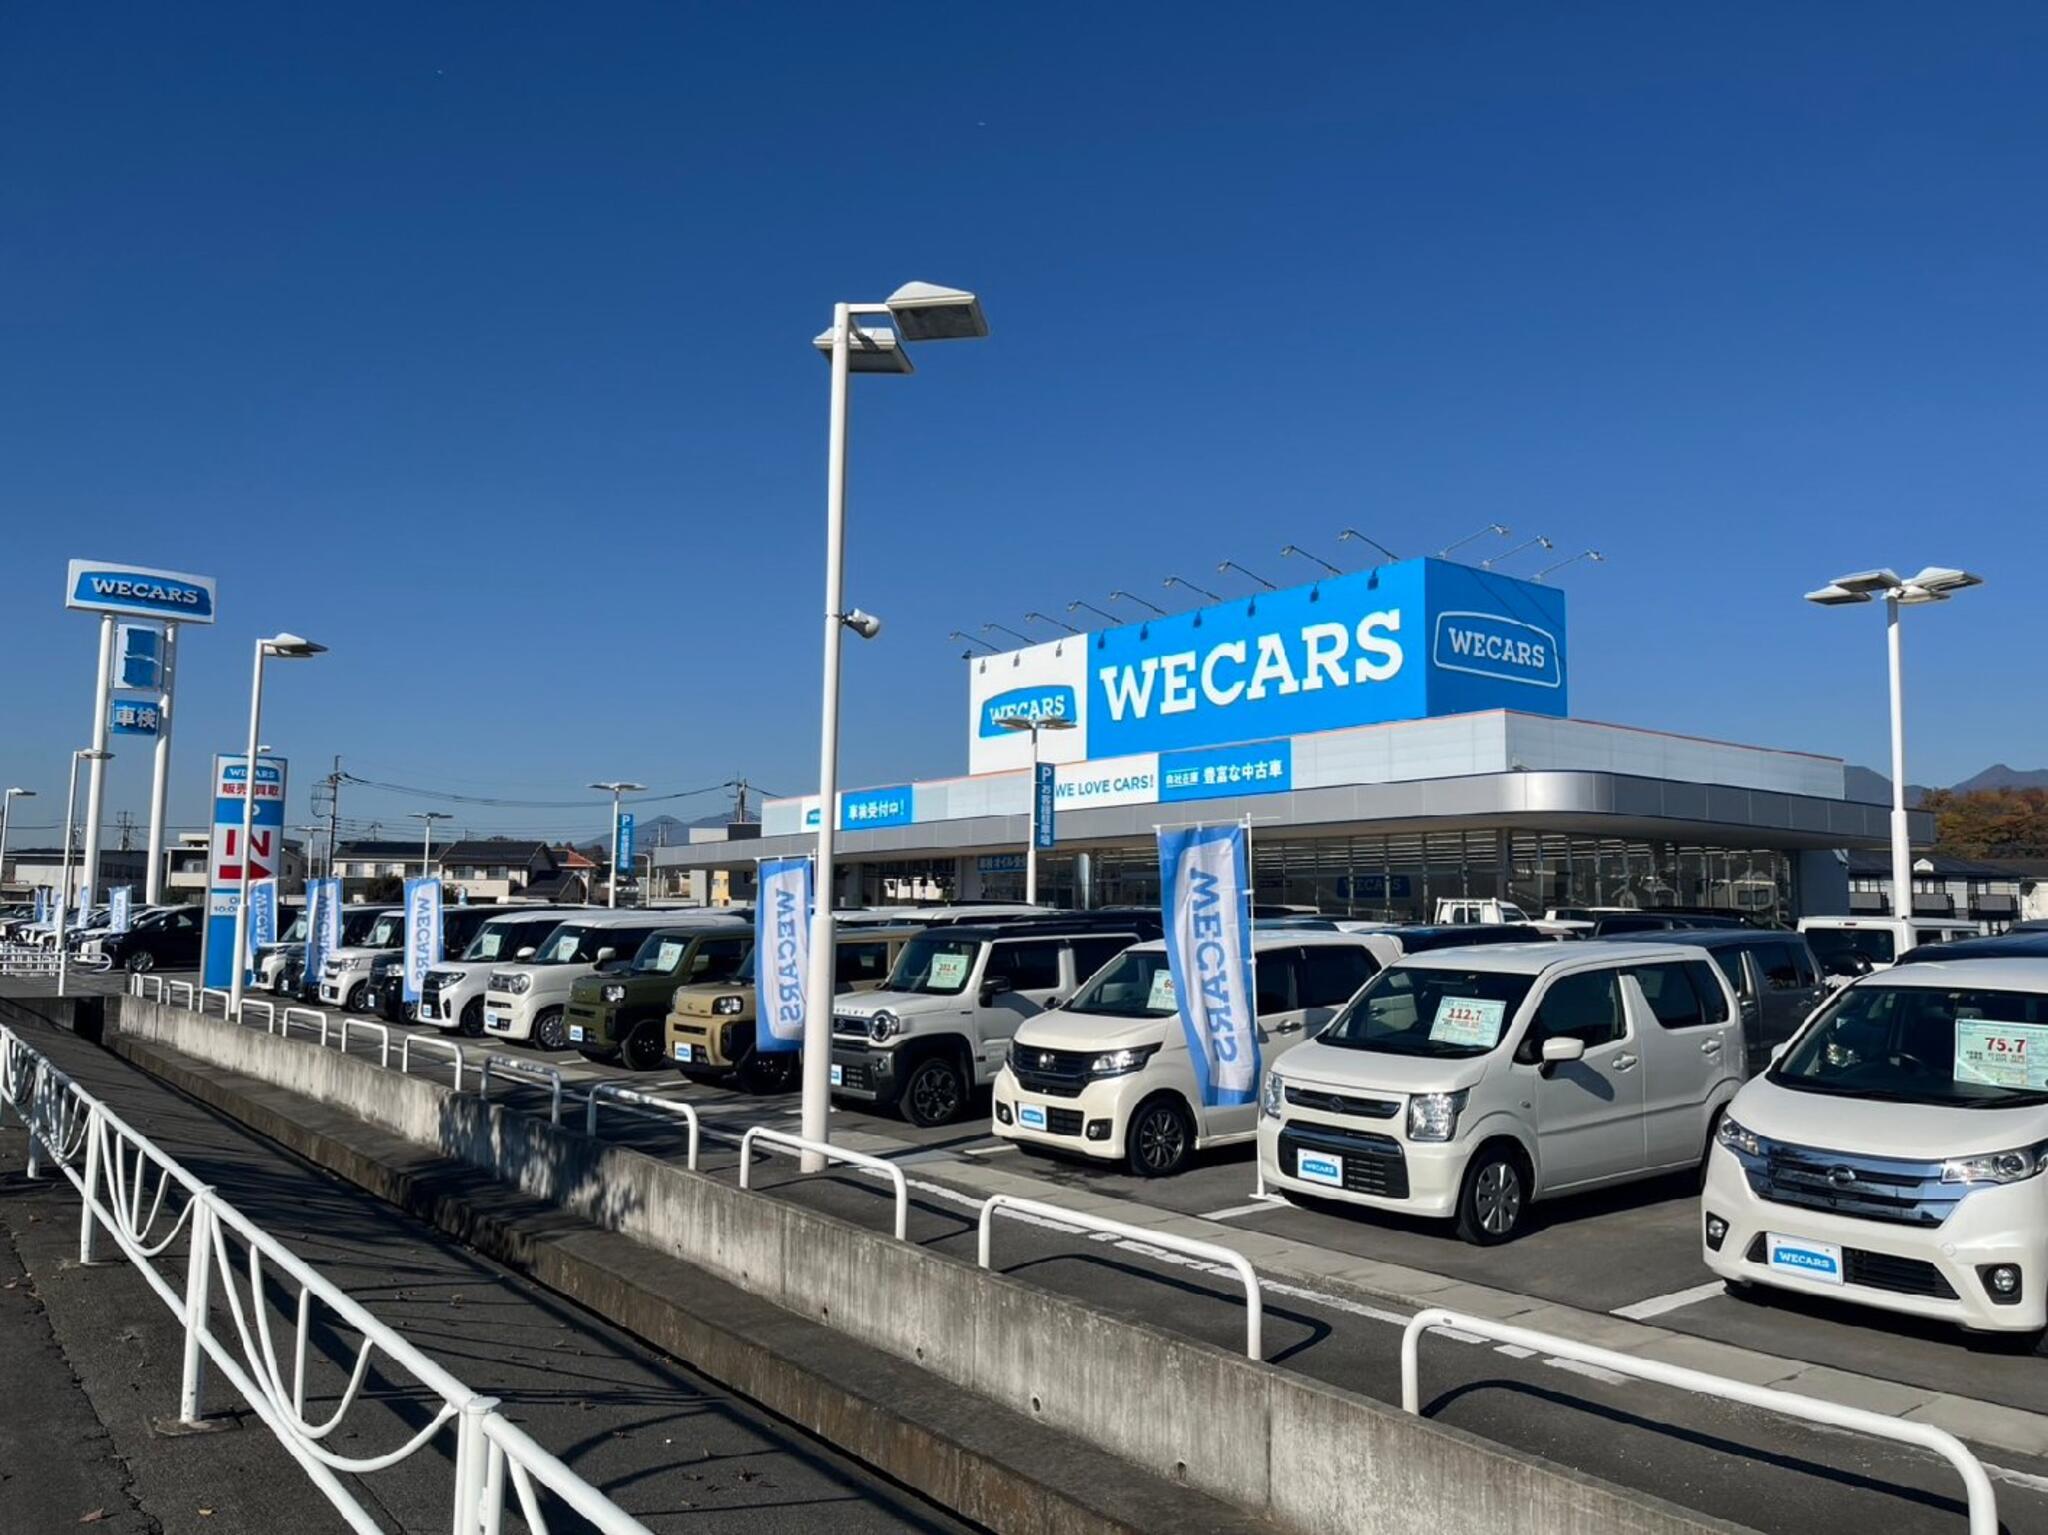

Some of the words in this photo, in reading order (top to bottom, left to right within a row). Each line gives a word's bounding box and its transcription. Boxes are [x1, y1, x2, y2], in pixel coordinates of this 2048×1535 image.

[91, 577, 198, 604] WECARS
[1448, 627, 1525, 669] WECARS
[1099, 608, 1404, 721] WECARS
[115, 706, 156, 728] 車検
[1042, 766, 1052, 782] P
[1203, 759, 1282, 784] 豊富な中古車
[1055, 782, 1075, 797] WE
[1078, 779, 1110, 796] LOVE
[1113, 774, 1154, 791] CARS!
[1448, 1008, 1482, 1021] 112.7
[1985, 1037, 2026, 1053] 75.7
[1779, 1251, 1829, 1269] WECARS
